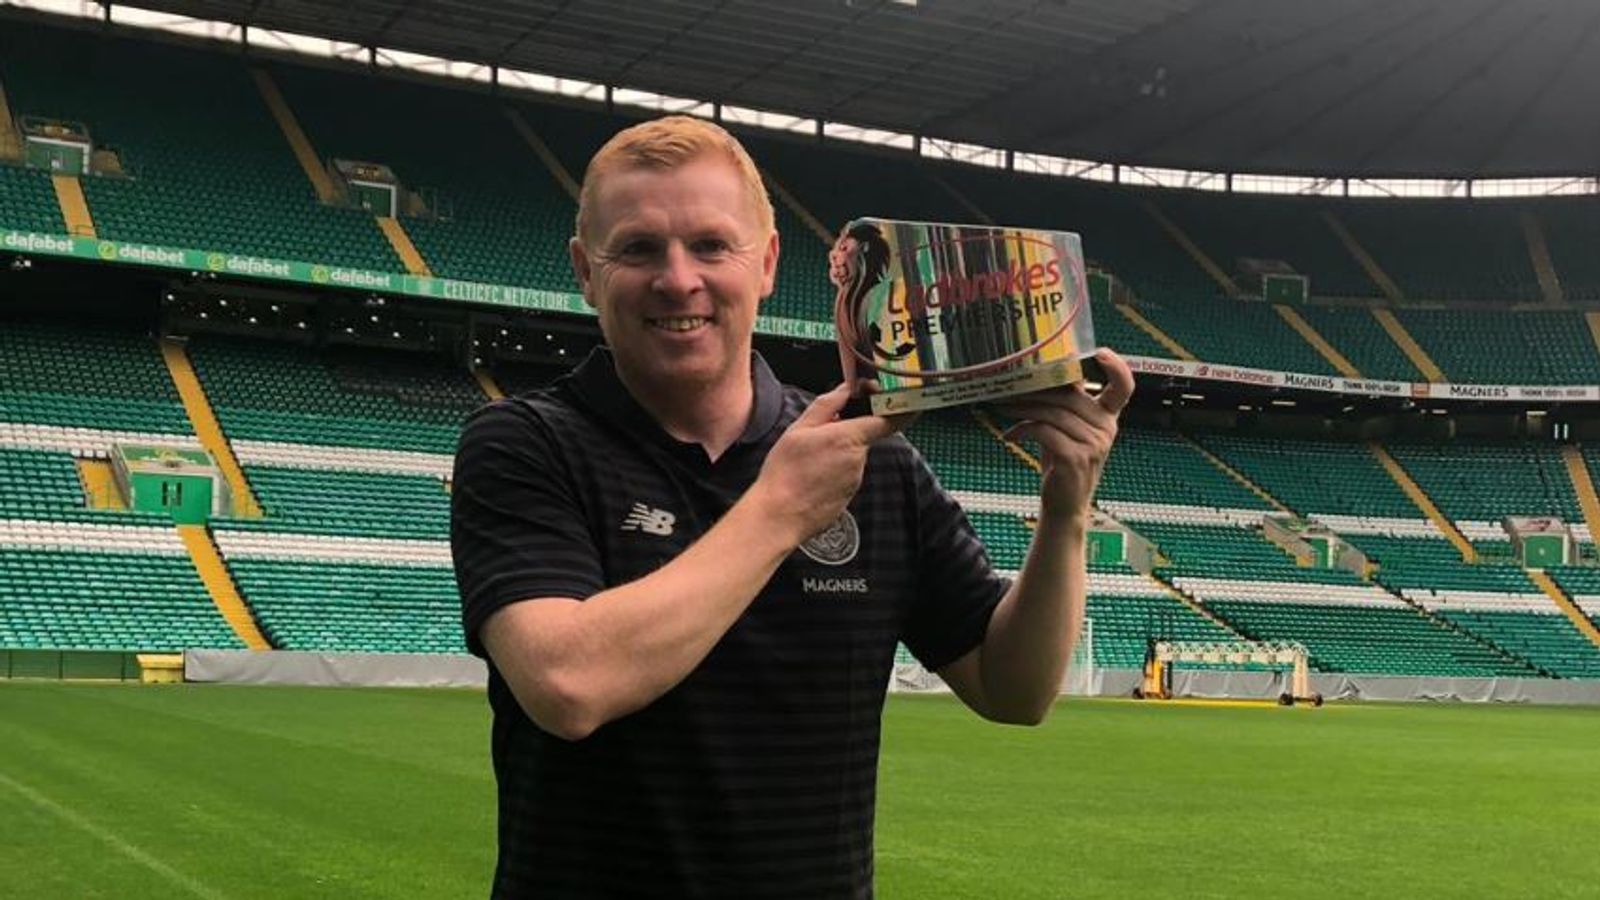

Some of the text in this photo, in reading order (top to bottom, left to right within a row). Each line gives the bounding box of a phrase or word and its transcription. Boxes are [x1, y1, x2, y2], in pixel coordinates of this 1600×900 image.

[5, 231, 73, 252] dafabet
[119, 244, 185, 264] dafabet
[227, 256, 289, 276] dafabet
[331, 268, 390, 287] dafabet
[888, 259, 1060, 315] Ladbrokes
[891, 291, 1063, 341] PREMIERSHIP
[1285, 373, 1334, 390] MAGNERS
[1451, 386, 1508, 398] MAGNERS
[803, 577, 868, 592] MAGNERS
